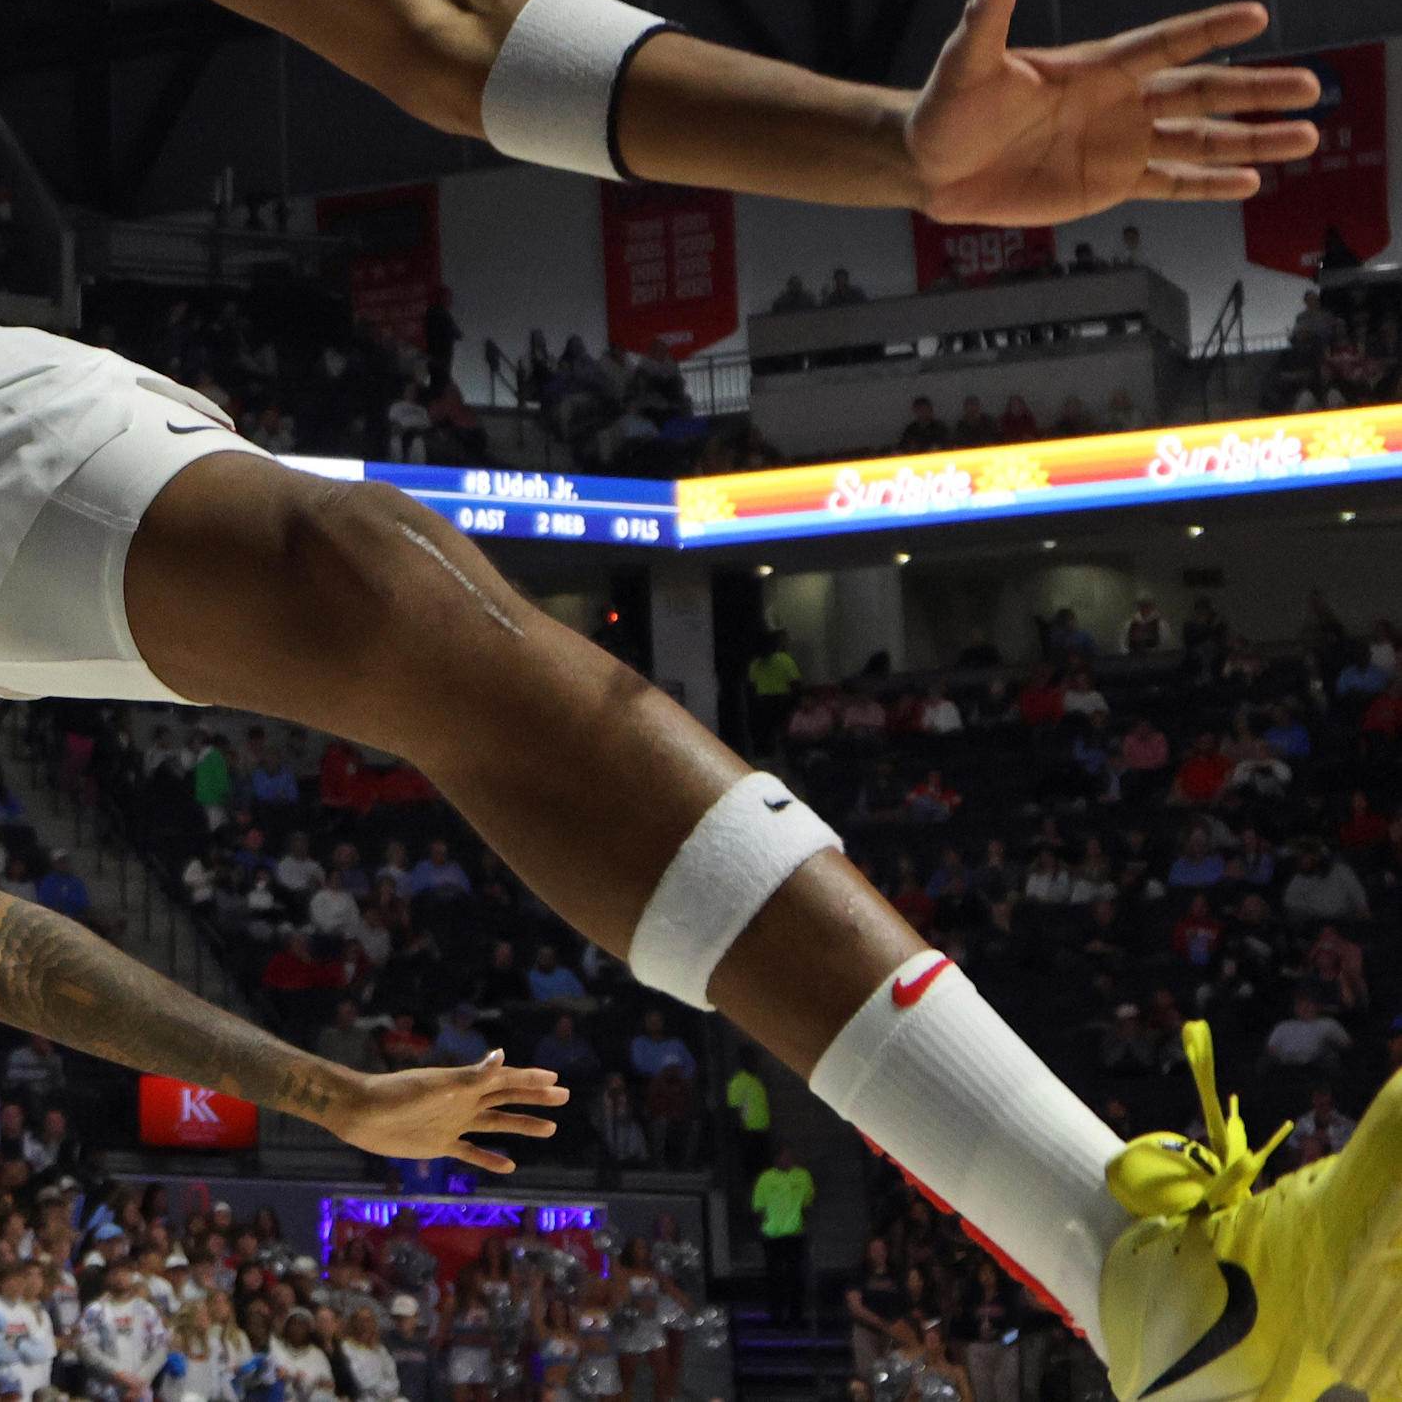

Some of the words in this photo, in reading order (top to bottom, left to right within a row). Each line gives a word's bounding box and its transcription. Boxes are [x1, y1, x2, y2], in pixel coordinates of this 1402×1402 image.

[1149, 429, 1303, 483] Surfside
[553, 476, 579, 501] Jr.
[828, 463, 972, 516] Surfside
[474, 509, 506, 531] AST
[537, 512, 550, 535] 2
